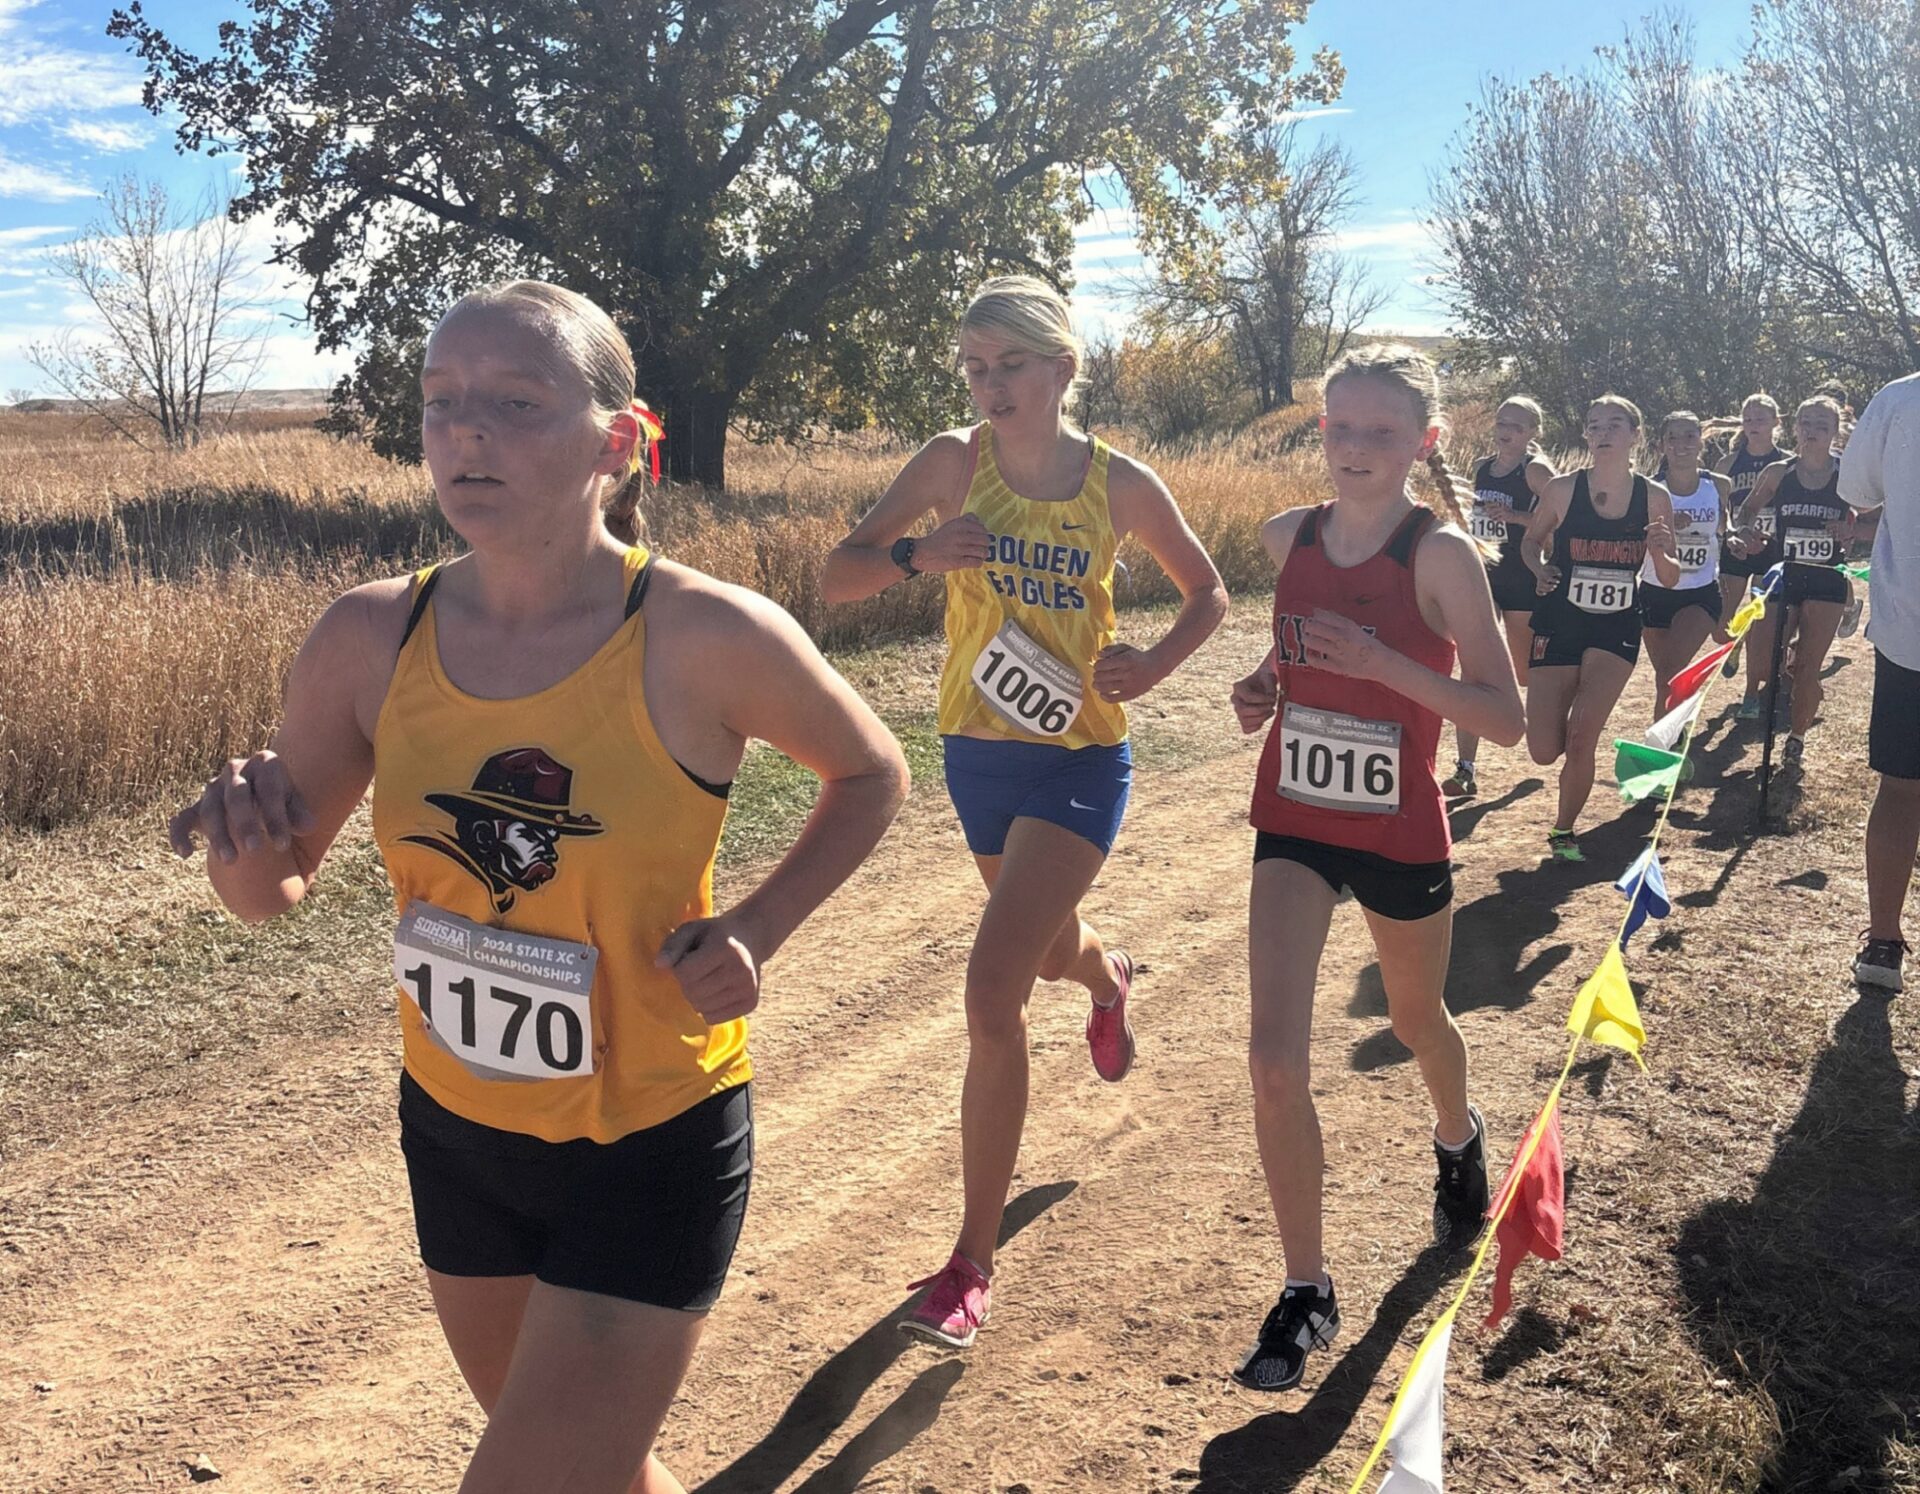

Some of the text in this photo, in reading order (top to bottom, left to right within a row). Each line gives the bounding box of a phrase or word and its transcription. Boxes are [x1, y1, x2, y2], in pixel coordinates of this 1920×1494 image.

[1754, 517, 1773, 532] 37
[1781, 503, 1841, 520] SPEARFISH
[1471, 518, 1506, 538] 1196
[1573, 582, 1627, 607] 1181
[981, 649, 1074, 733] 1006
[1286, 738, 1393, 796] 1016
[413, 916, 466, 947] SDHSAA
[482, 936, 576, 966] 2024 STATE XC
[473, 950, 582, 985] CHAMPIONSHIPS
[404, 961, 584, 1072] 1170
